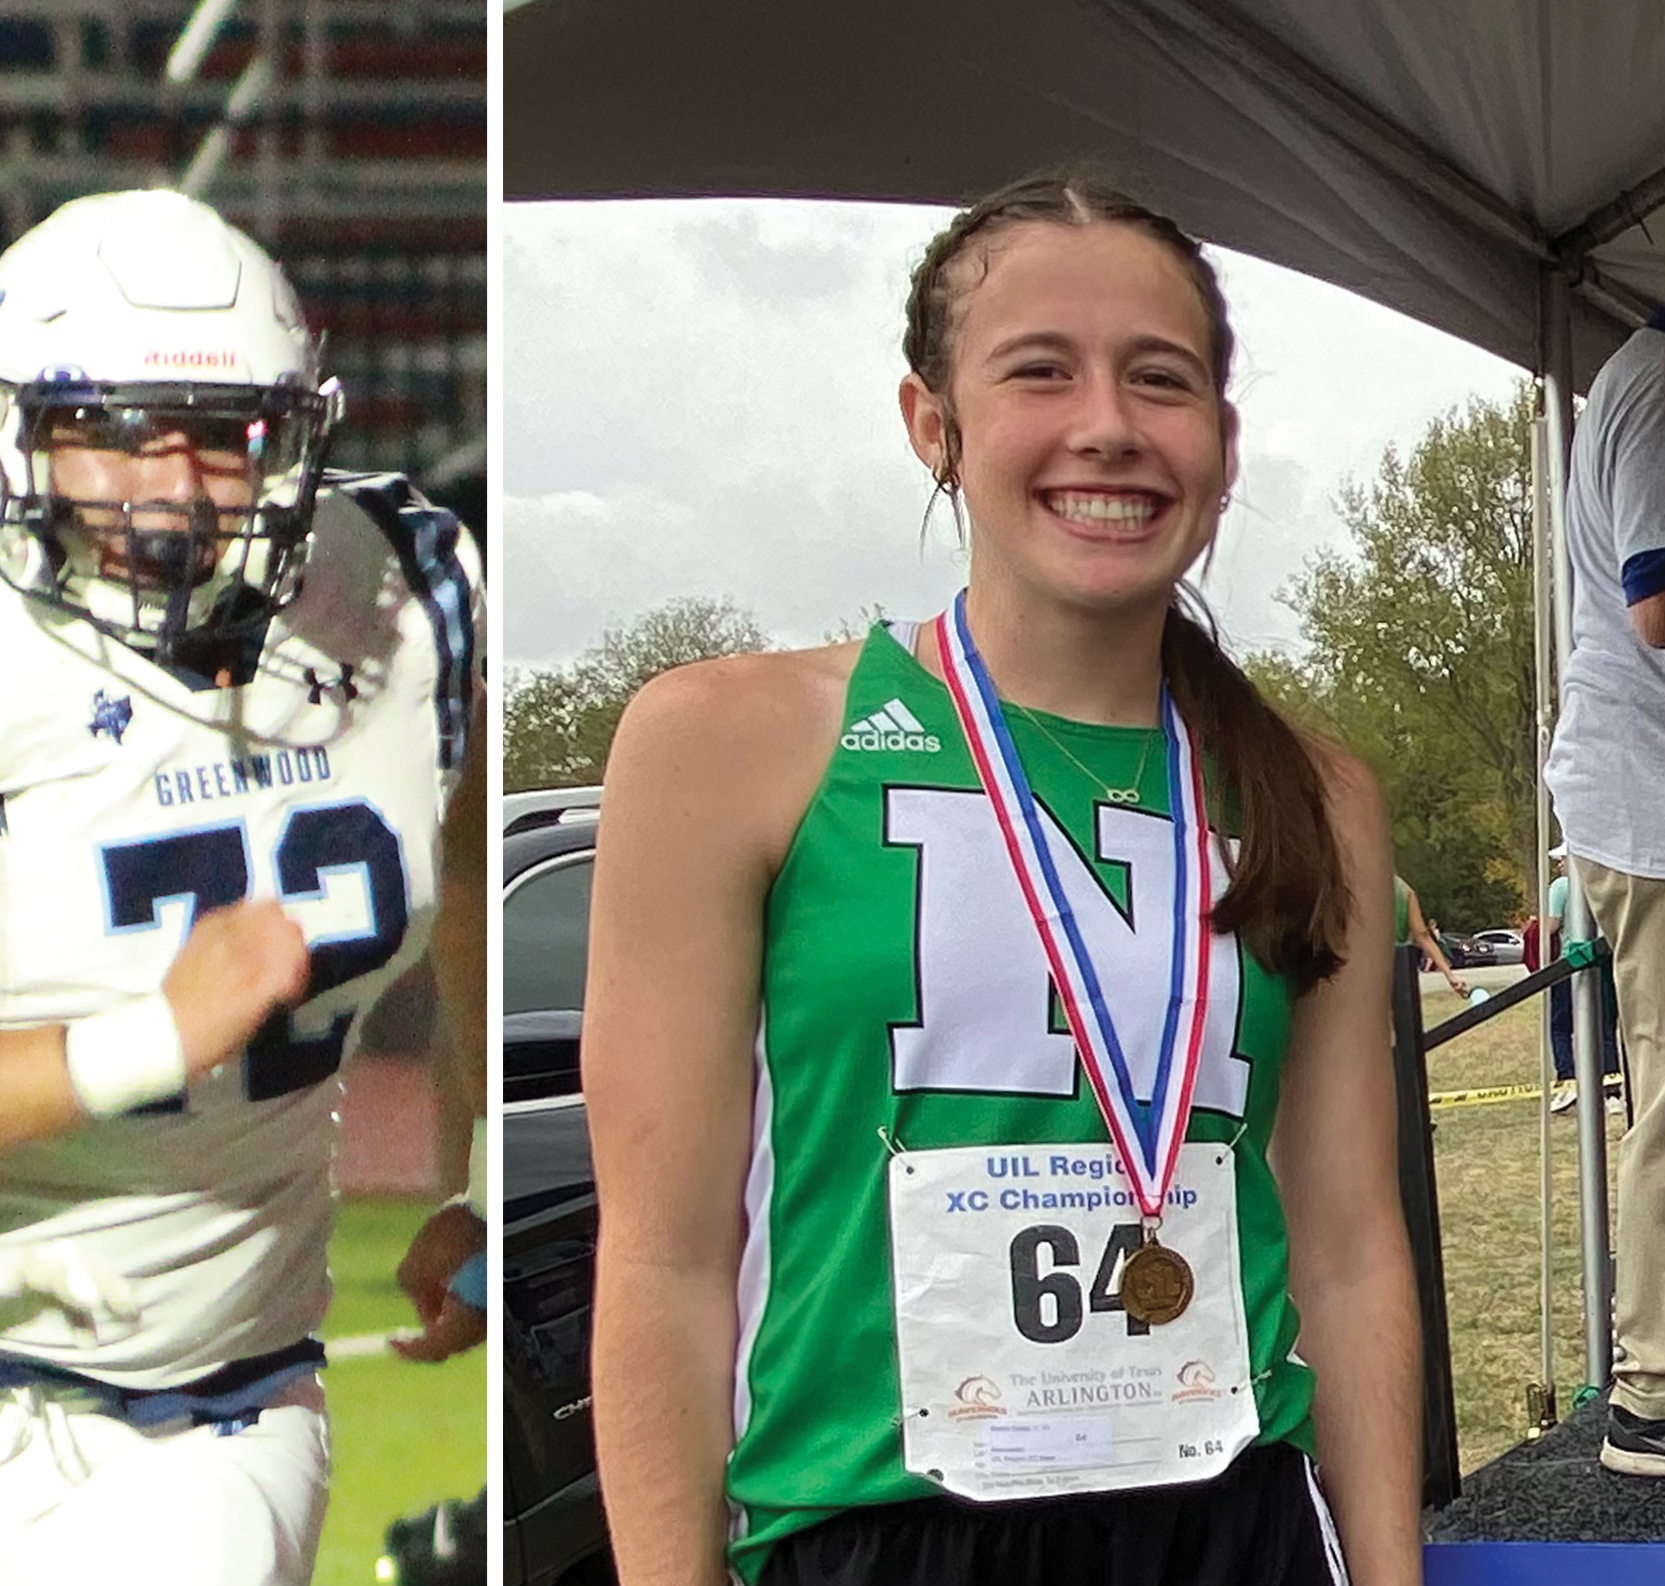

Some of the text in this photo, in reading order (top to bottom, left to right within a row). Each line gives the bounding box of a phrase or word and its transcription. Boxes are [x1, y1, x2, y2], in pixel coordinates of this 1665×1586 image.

[841, 731, 941, 753] adidas
[154, 745, 332, 807] GREENWOOD
[93, 796, 411, 1114] 72
[882, 783, 1254, 1120] N
[987, 1156, 1040, 1178] UIL
[946, 1184, 1198, 1213] XC Champioip
[1009, 1224, 1151, 1344] 64
[1026, 1381, 1152, 1408] ARLINGTON
